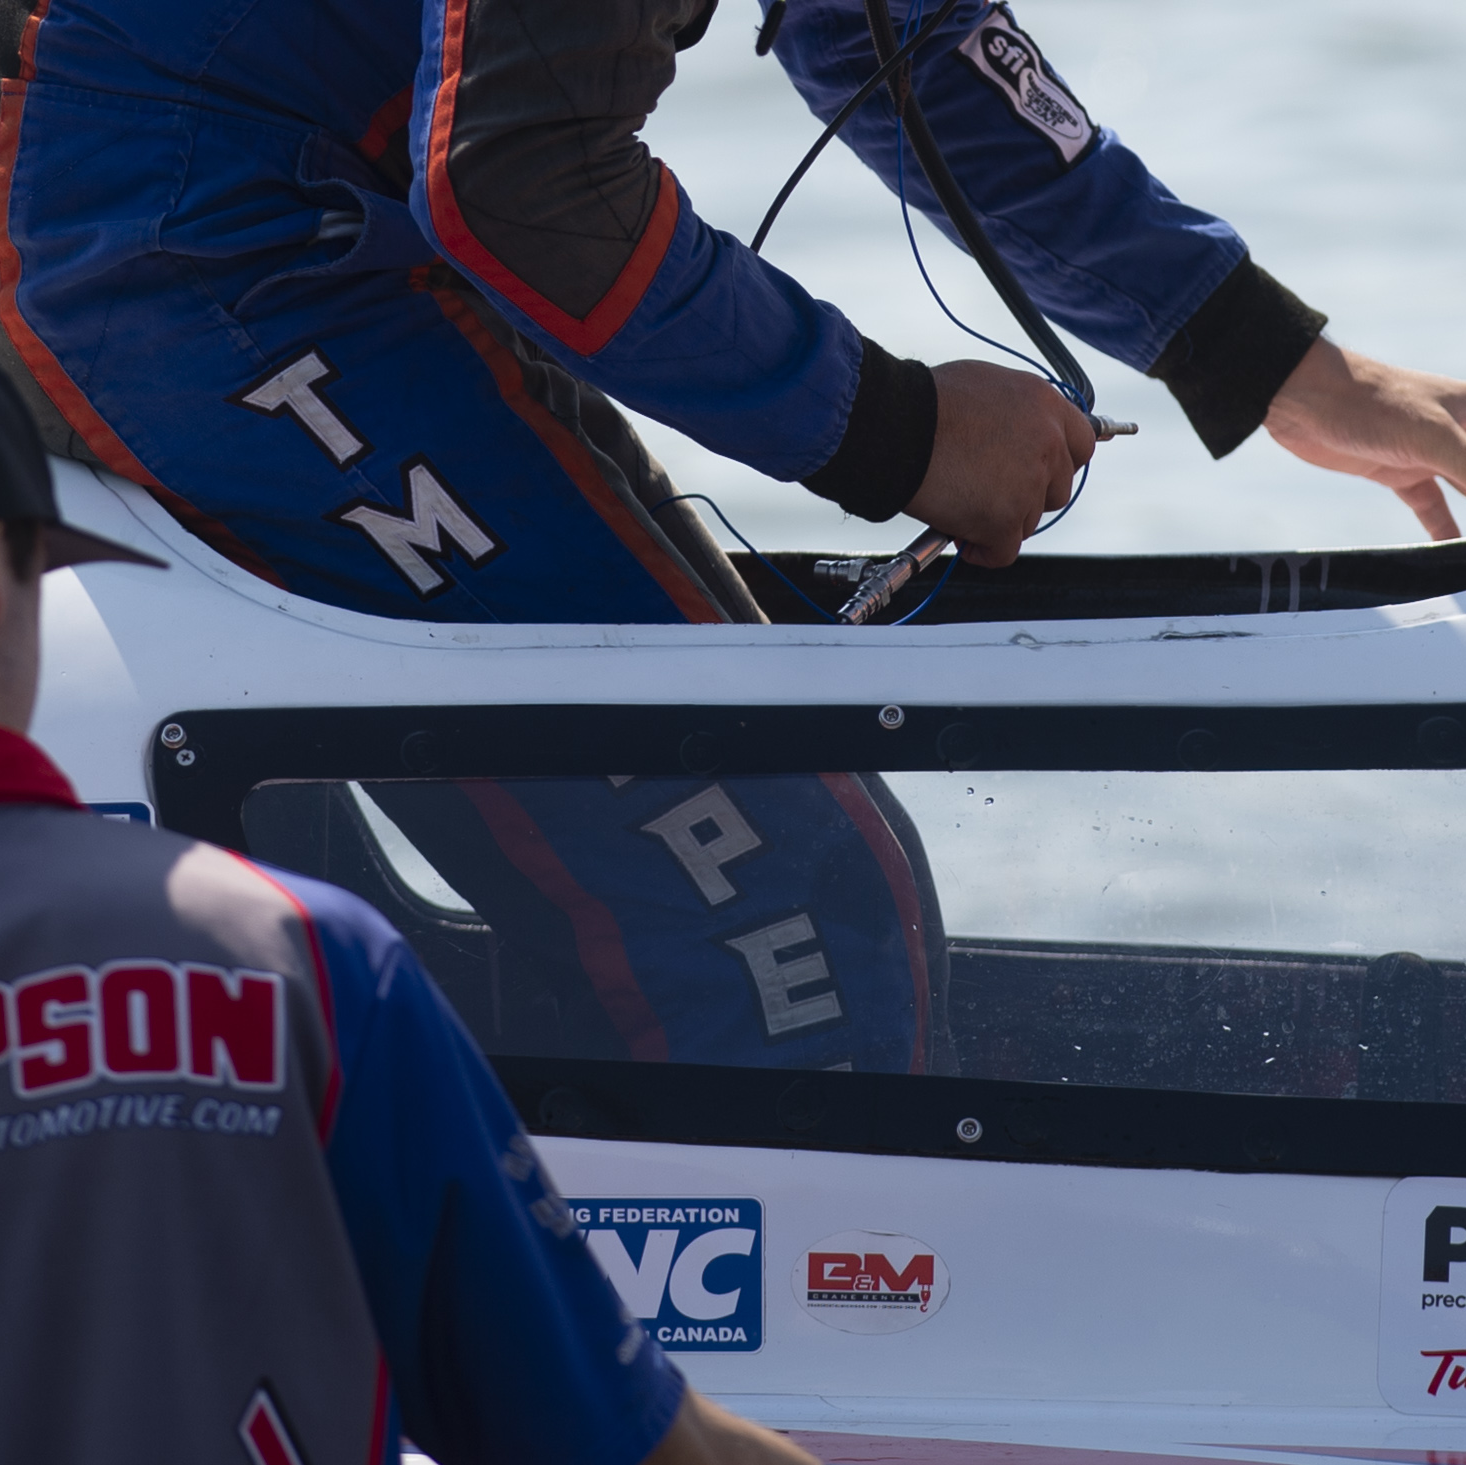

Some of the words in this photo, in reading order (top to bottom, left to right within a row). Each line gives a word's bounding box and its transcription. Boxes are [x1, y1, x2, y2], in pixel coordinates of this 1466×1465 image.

[988, 35, 1029, 74] sfi
[599, 1208, 740, 1224] FEDERATION
[807, 1251, 935, 1292] B&M
[657, 1326, 748, 1343] CANADA
